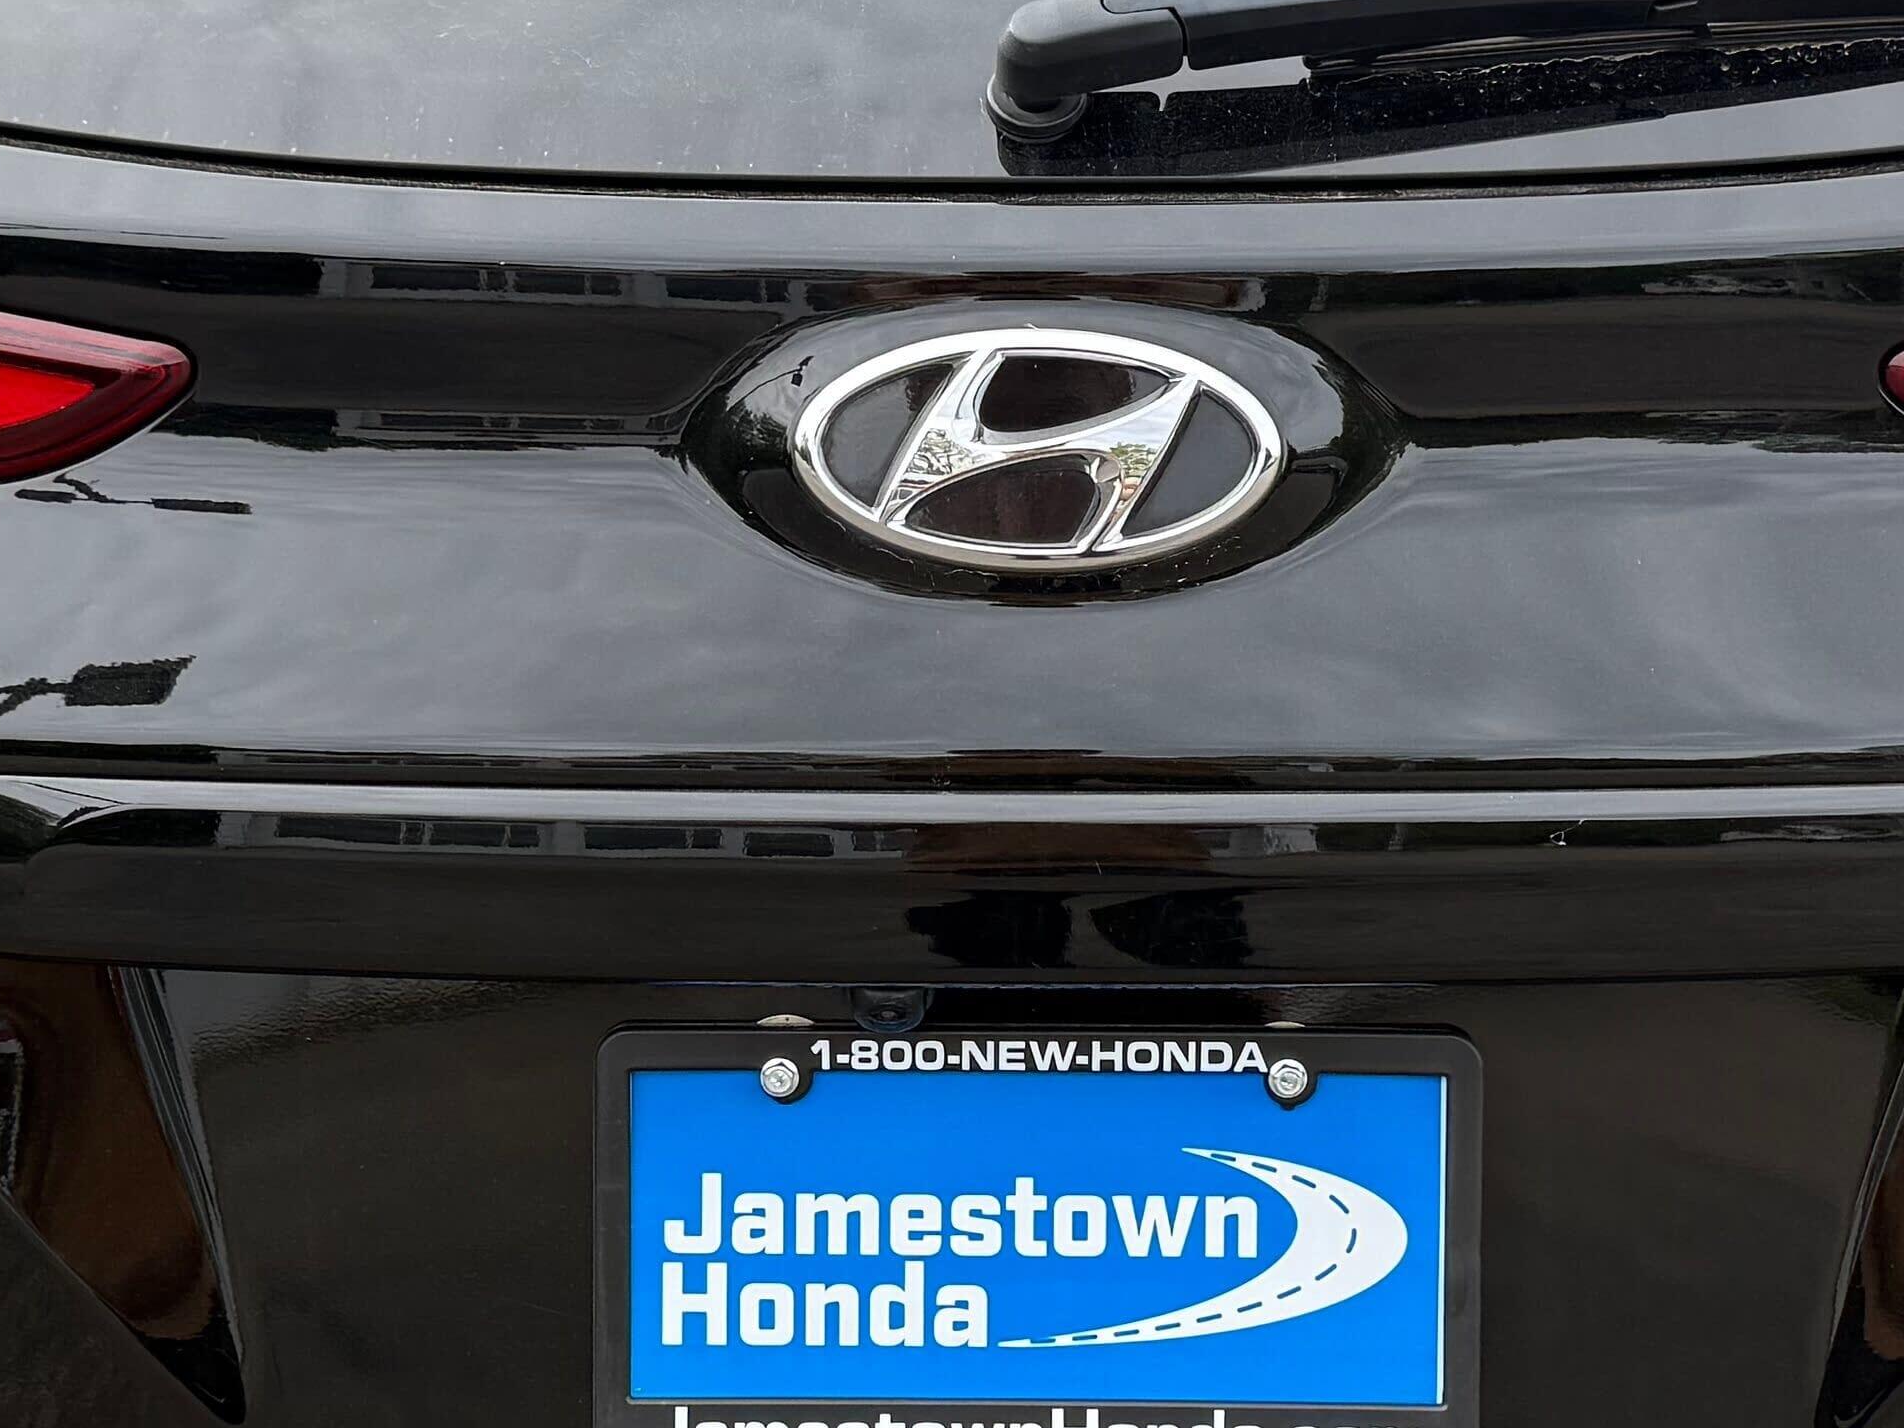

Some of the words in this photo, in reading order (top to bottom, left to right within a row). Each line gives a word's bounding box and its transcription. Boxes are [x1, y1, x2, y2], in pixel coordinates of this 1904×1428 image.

[810, 1039, 1268, 1073] 1-800-NEW-HONDA
[664, 1172, 1258, 1258] Jamestown
[661, 1261, 989, 1349] Honda
